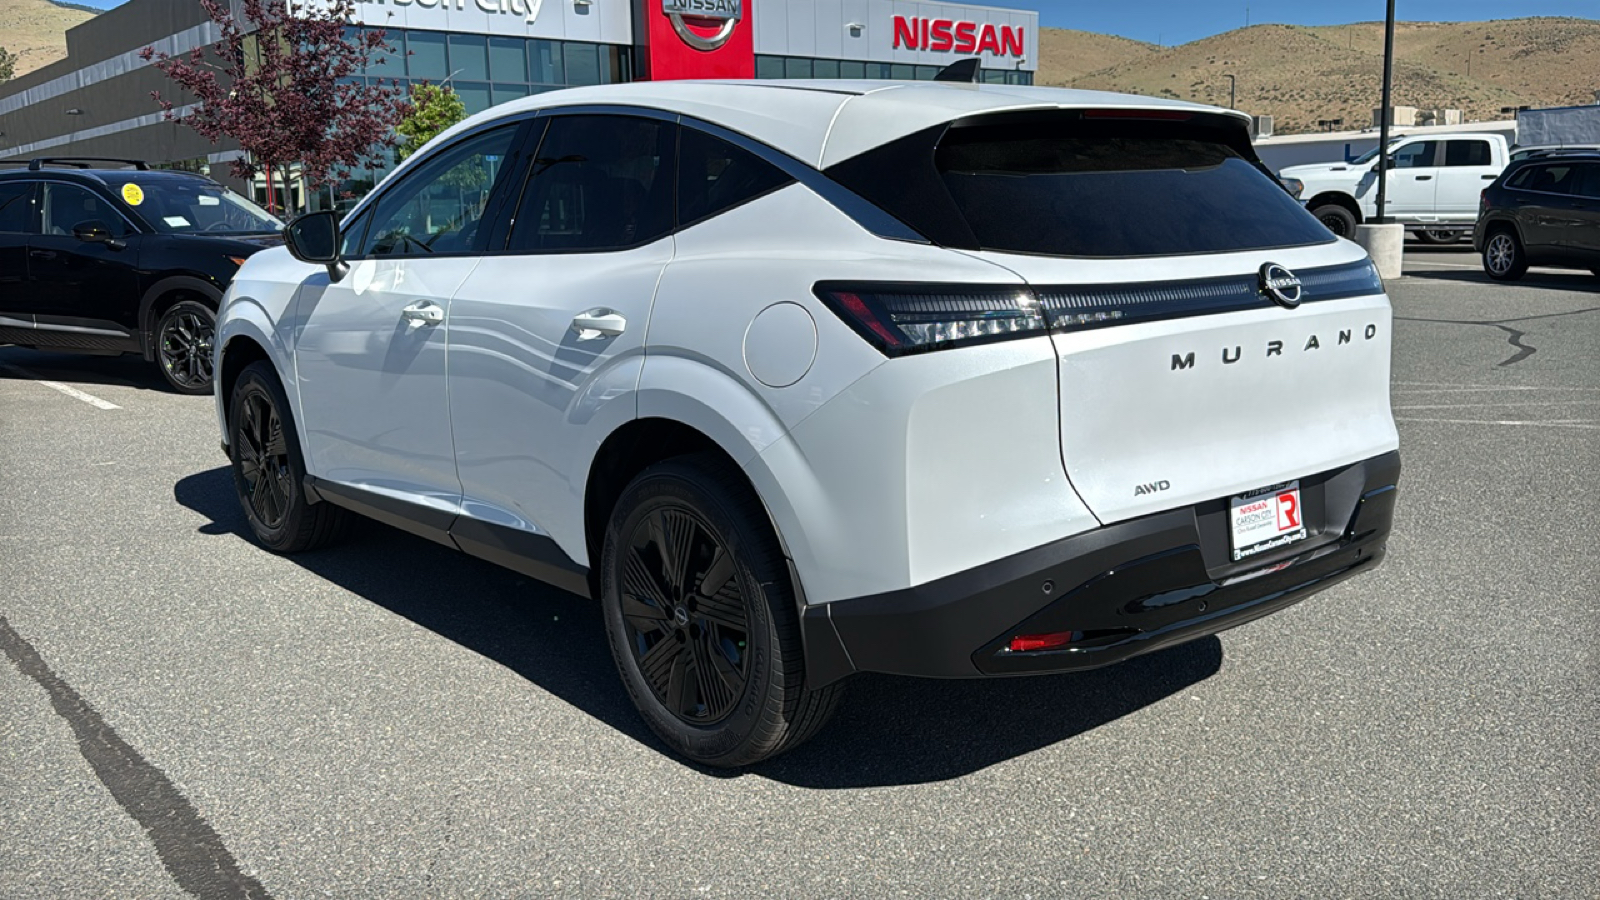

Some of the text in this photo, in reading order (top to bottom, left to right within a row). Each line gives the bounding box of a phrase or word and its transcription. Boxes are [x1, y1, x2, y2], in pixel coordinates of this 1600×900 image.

[673, 0, 737, 13] NISSAN
[893, 15, 1024, 57] NISSAN
[1269, 278, 1300, 287] NISSAN
[1171, 324, 1376, 370] MURANO
[1134, 480, 1171, 496] AWD
[1240, 501, 1268, 515] NISSAN
